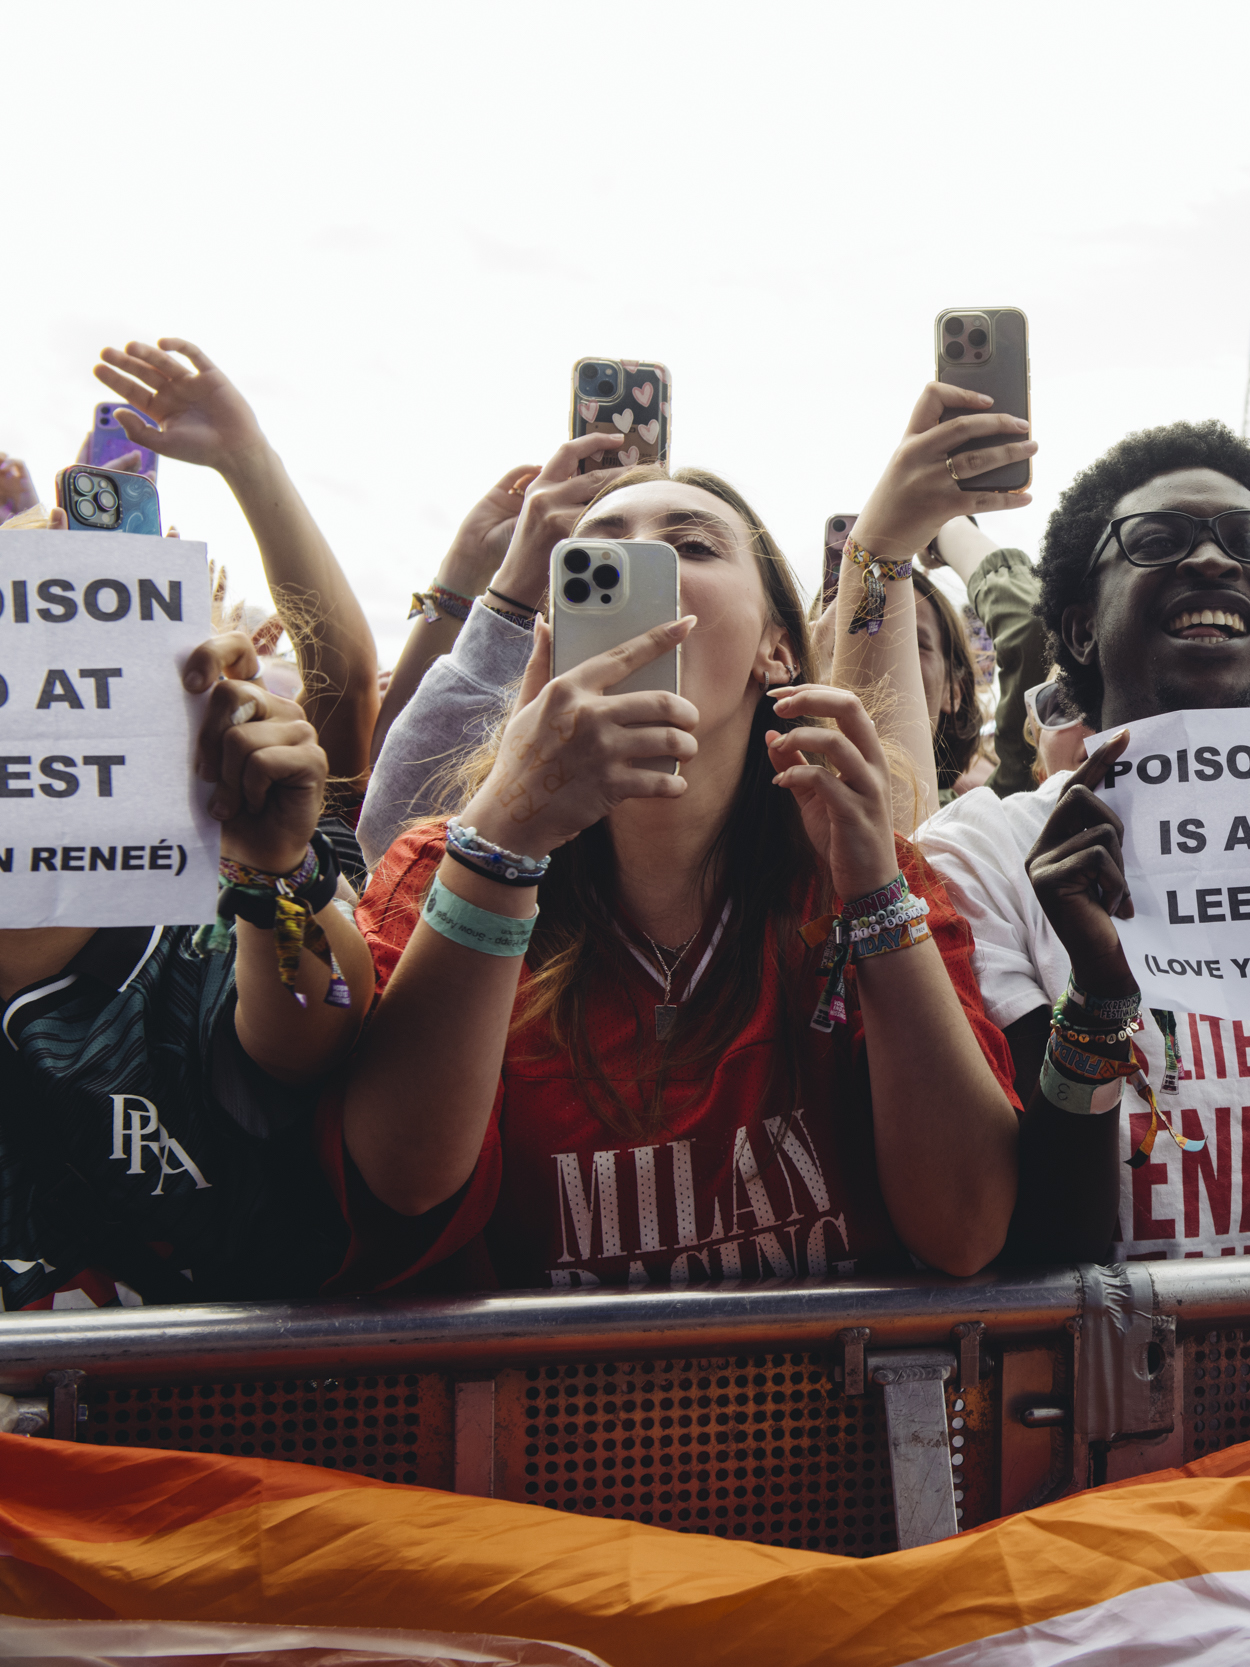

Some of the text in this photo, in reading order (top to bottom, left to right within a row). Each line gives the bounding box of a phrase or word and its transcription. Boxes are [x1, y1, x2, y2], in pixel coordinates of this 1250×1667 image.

[35, 668, 123, 709] AT
[0, 755, 126, 798] EST
[1159, 817, 1207, 855] IS
[30, 839, 188, 876] RENEÉ)
[843, 880, 904, 921] SUNDAY
[458, 924, 486, 941] Snow
[850, 924, 880, 942] ATE
[1144, 952, 1224, 979] (LOVE
[1050, 1032, 1103, 1076] FRIDA
[551, 1109, 831, 1262] MILAN
[545, 1211, 858, 1288] ING
